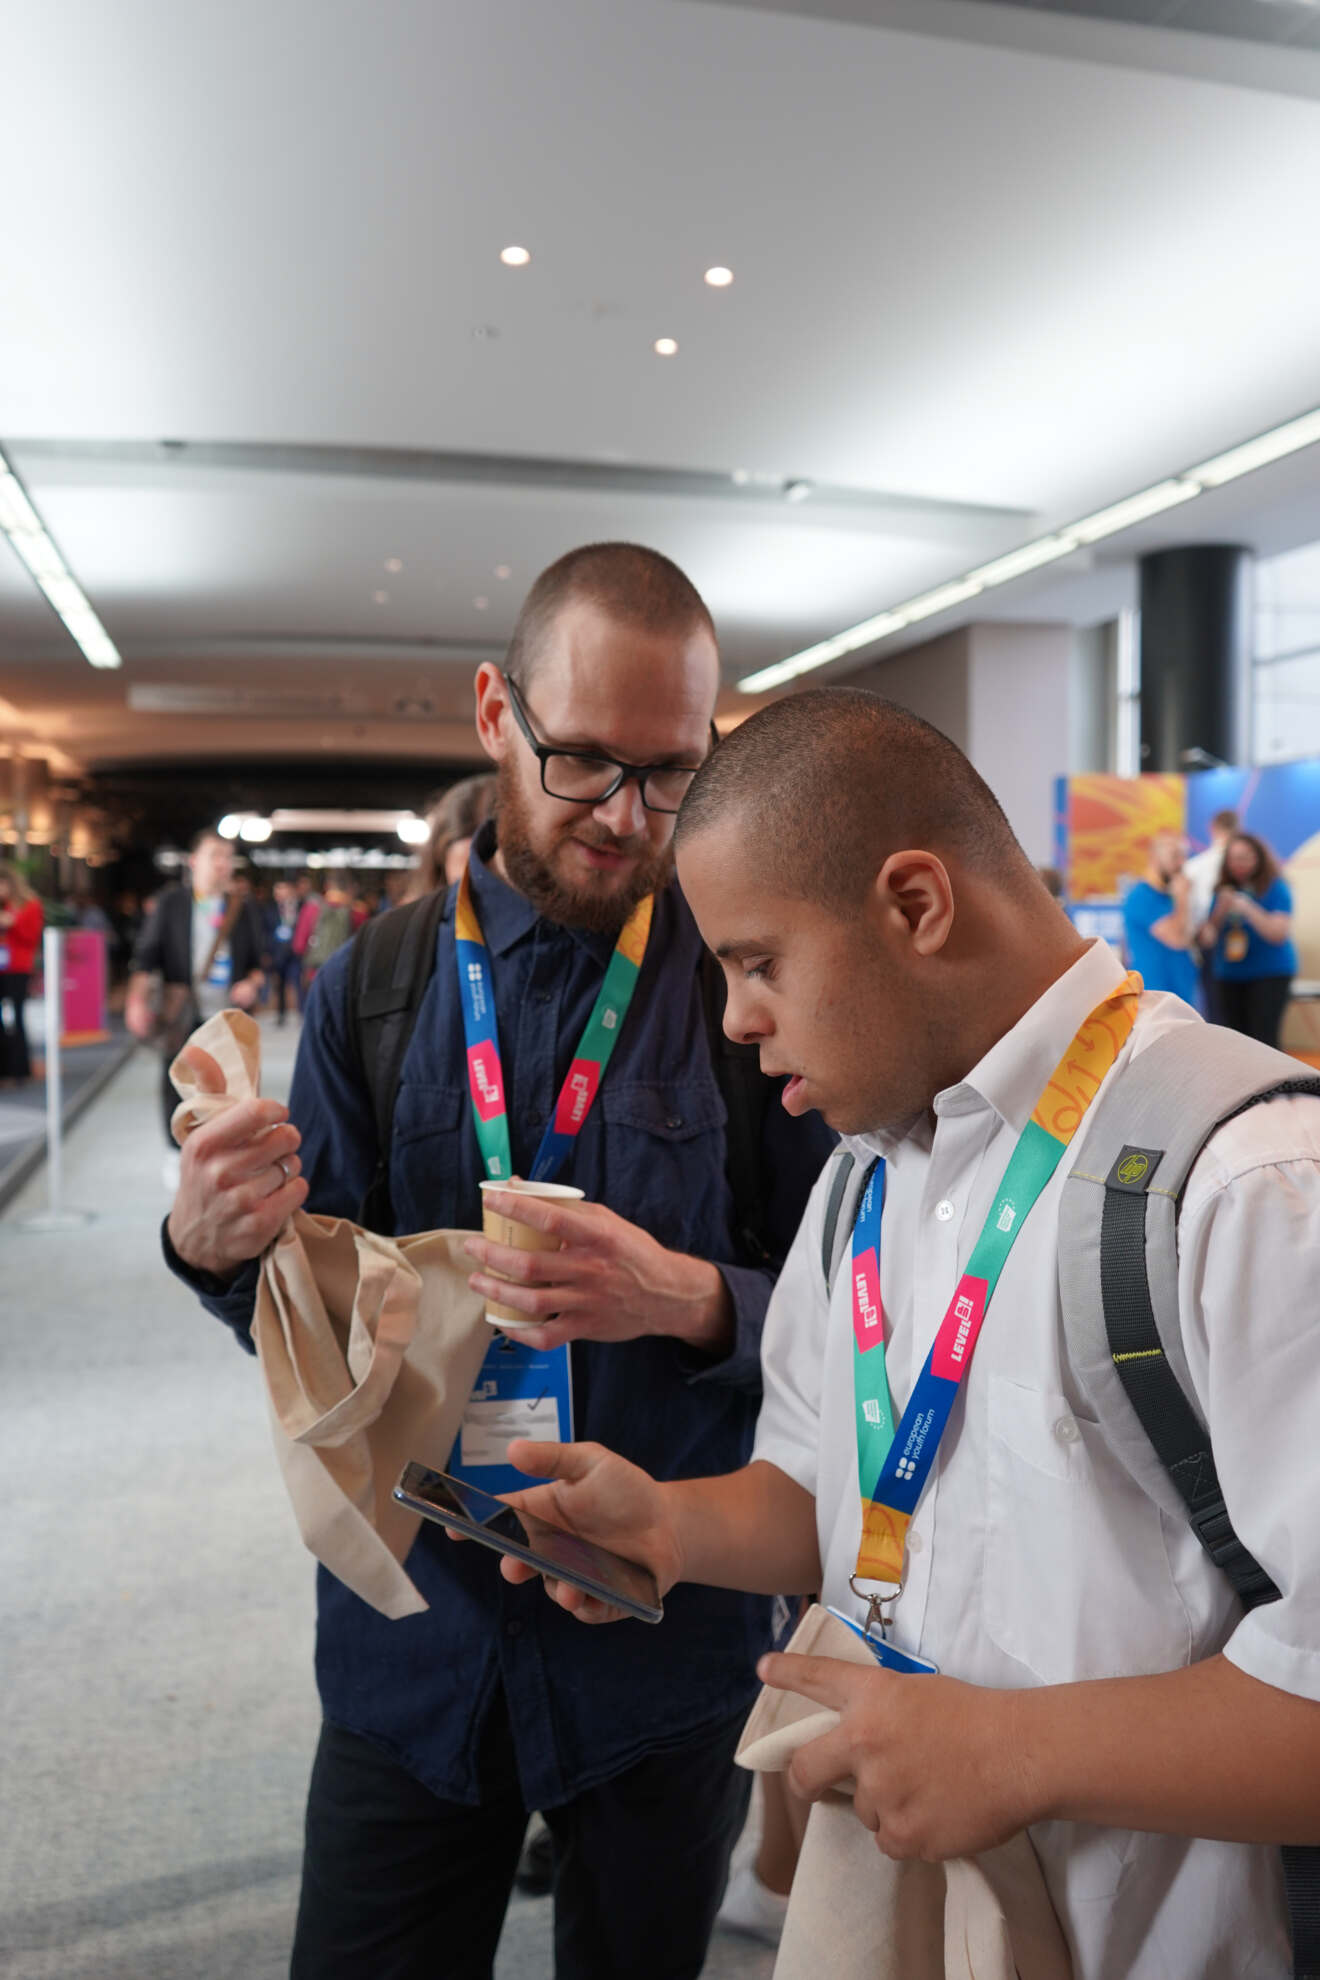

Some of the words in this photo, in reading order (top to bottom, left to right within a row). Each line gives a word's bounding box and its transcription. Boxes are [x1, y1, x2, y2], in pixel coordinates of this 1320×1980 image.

[856, 1272, 869, 1313] LEVEL
[951, 1319, 971, 1362] LEVEL
[903, 1412, 925, 1456] european
[912, 1433, 926, 1460] youth
[920, 1408, 935, 1436] forum
